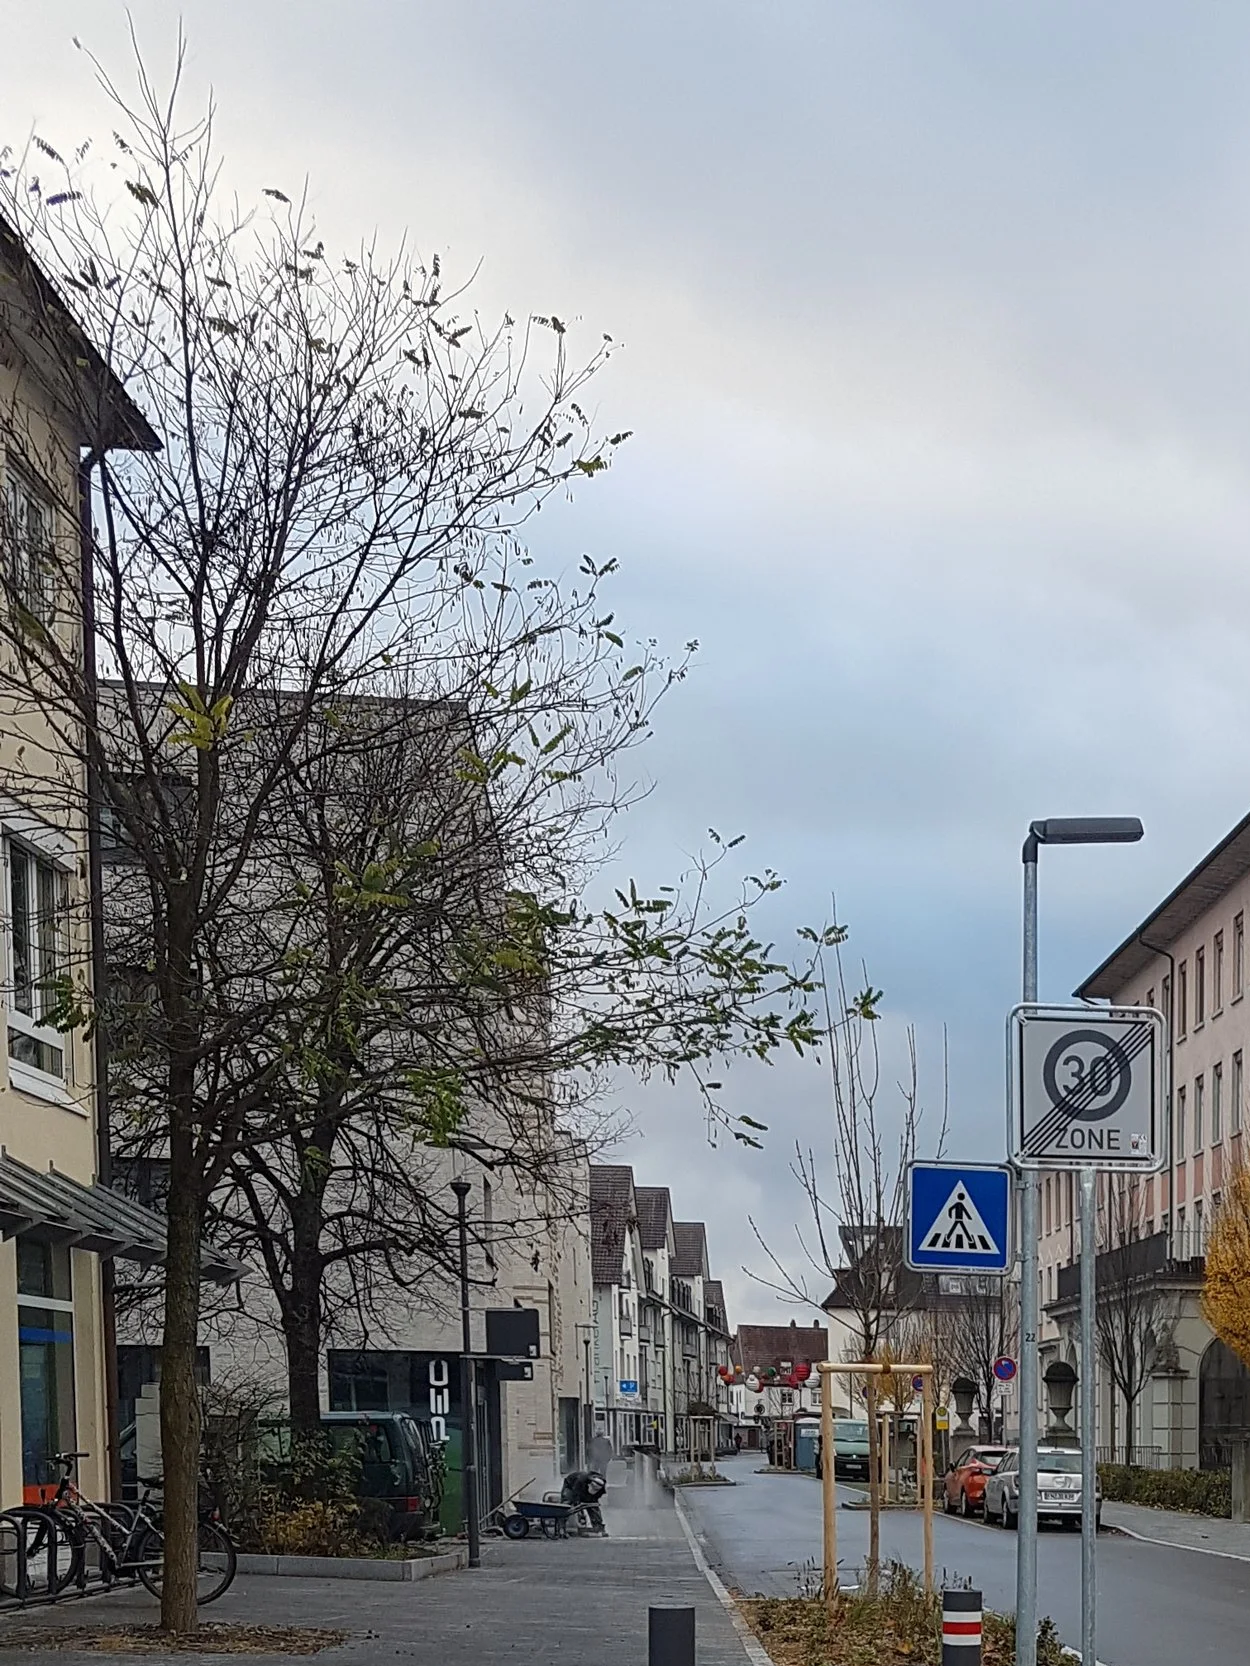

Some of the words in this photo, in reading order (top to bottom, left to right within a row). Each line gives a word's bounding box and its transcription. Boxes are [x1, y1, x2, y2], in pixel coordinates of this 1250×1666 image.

[1062, 1055, 1112, 1097] 30
[1055, 1127, 1121, 1150] ZONE
[1025, 1332, 1036, 1343] 22
